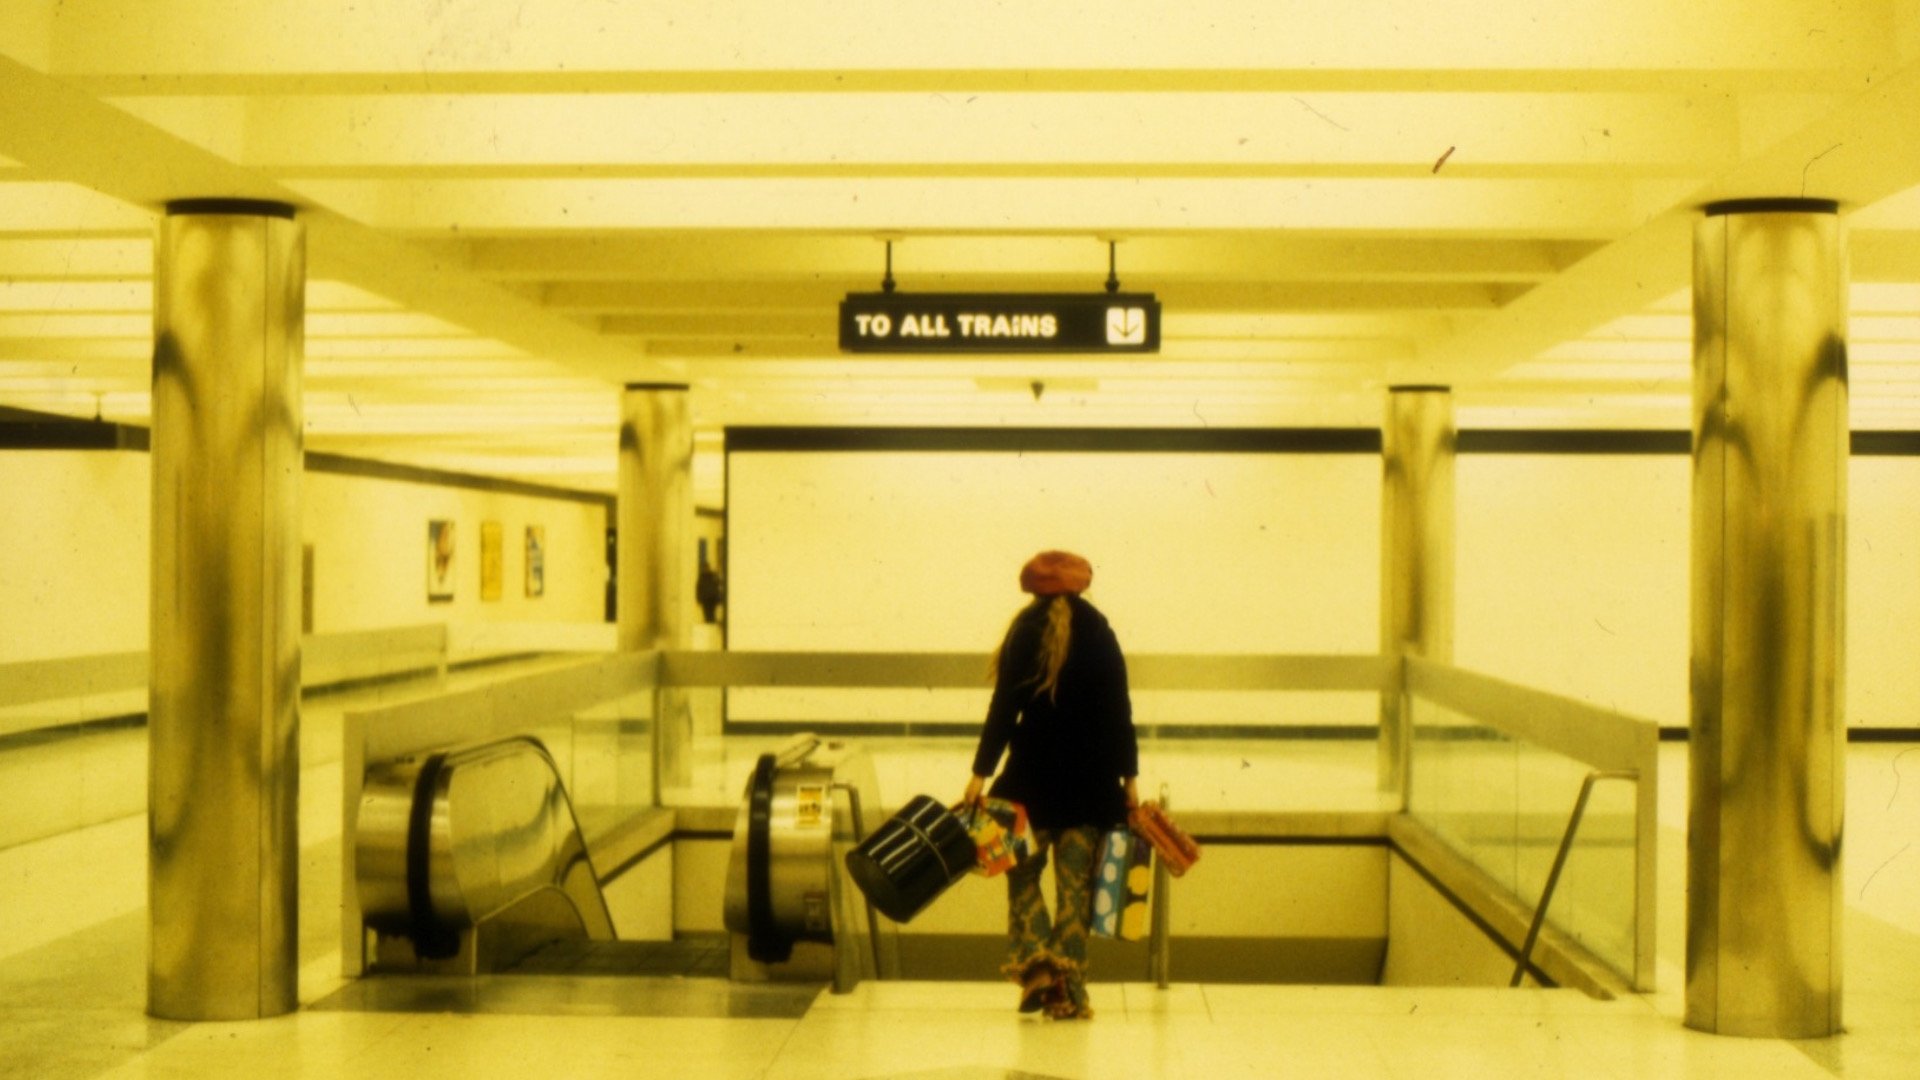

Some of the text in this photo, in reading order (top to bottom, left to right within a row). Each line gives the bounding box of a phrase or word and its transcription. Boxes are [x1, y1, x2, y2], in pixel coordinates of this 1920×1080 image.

[856, 314, 1057, 338] TO ALL TRAINS
